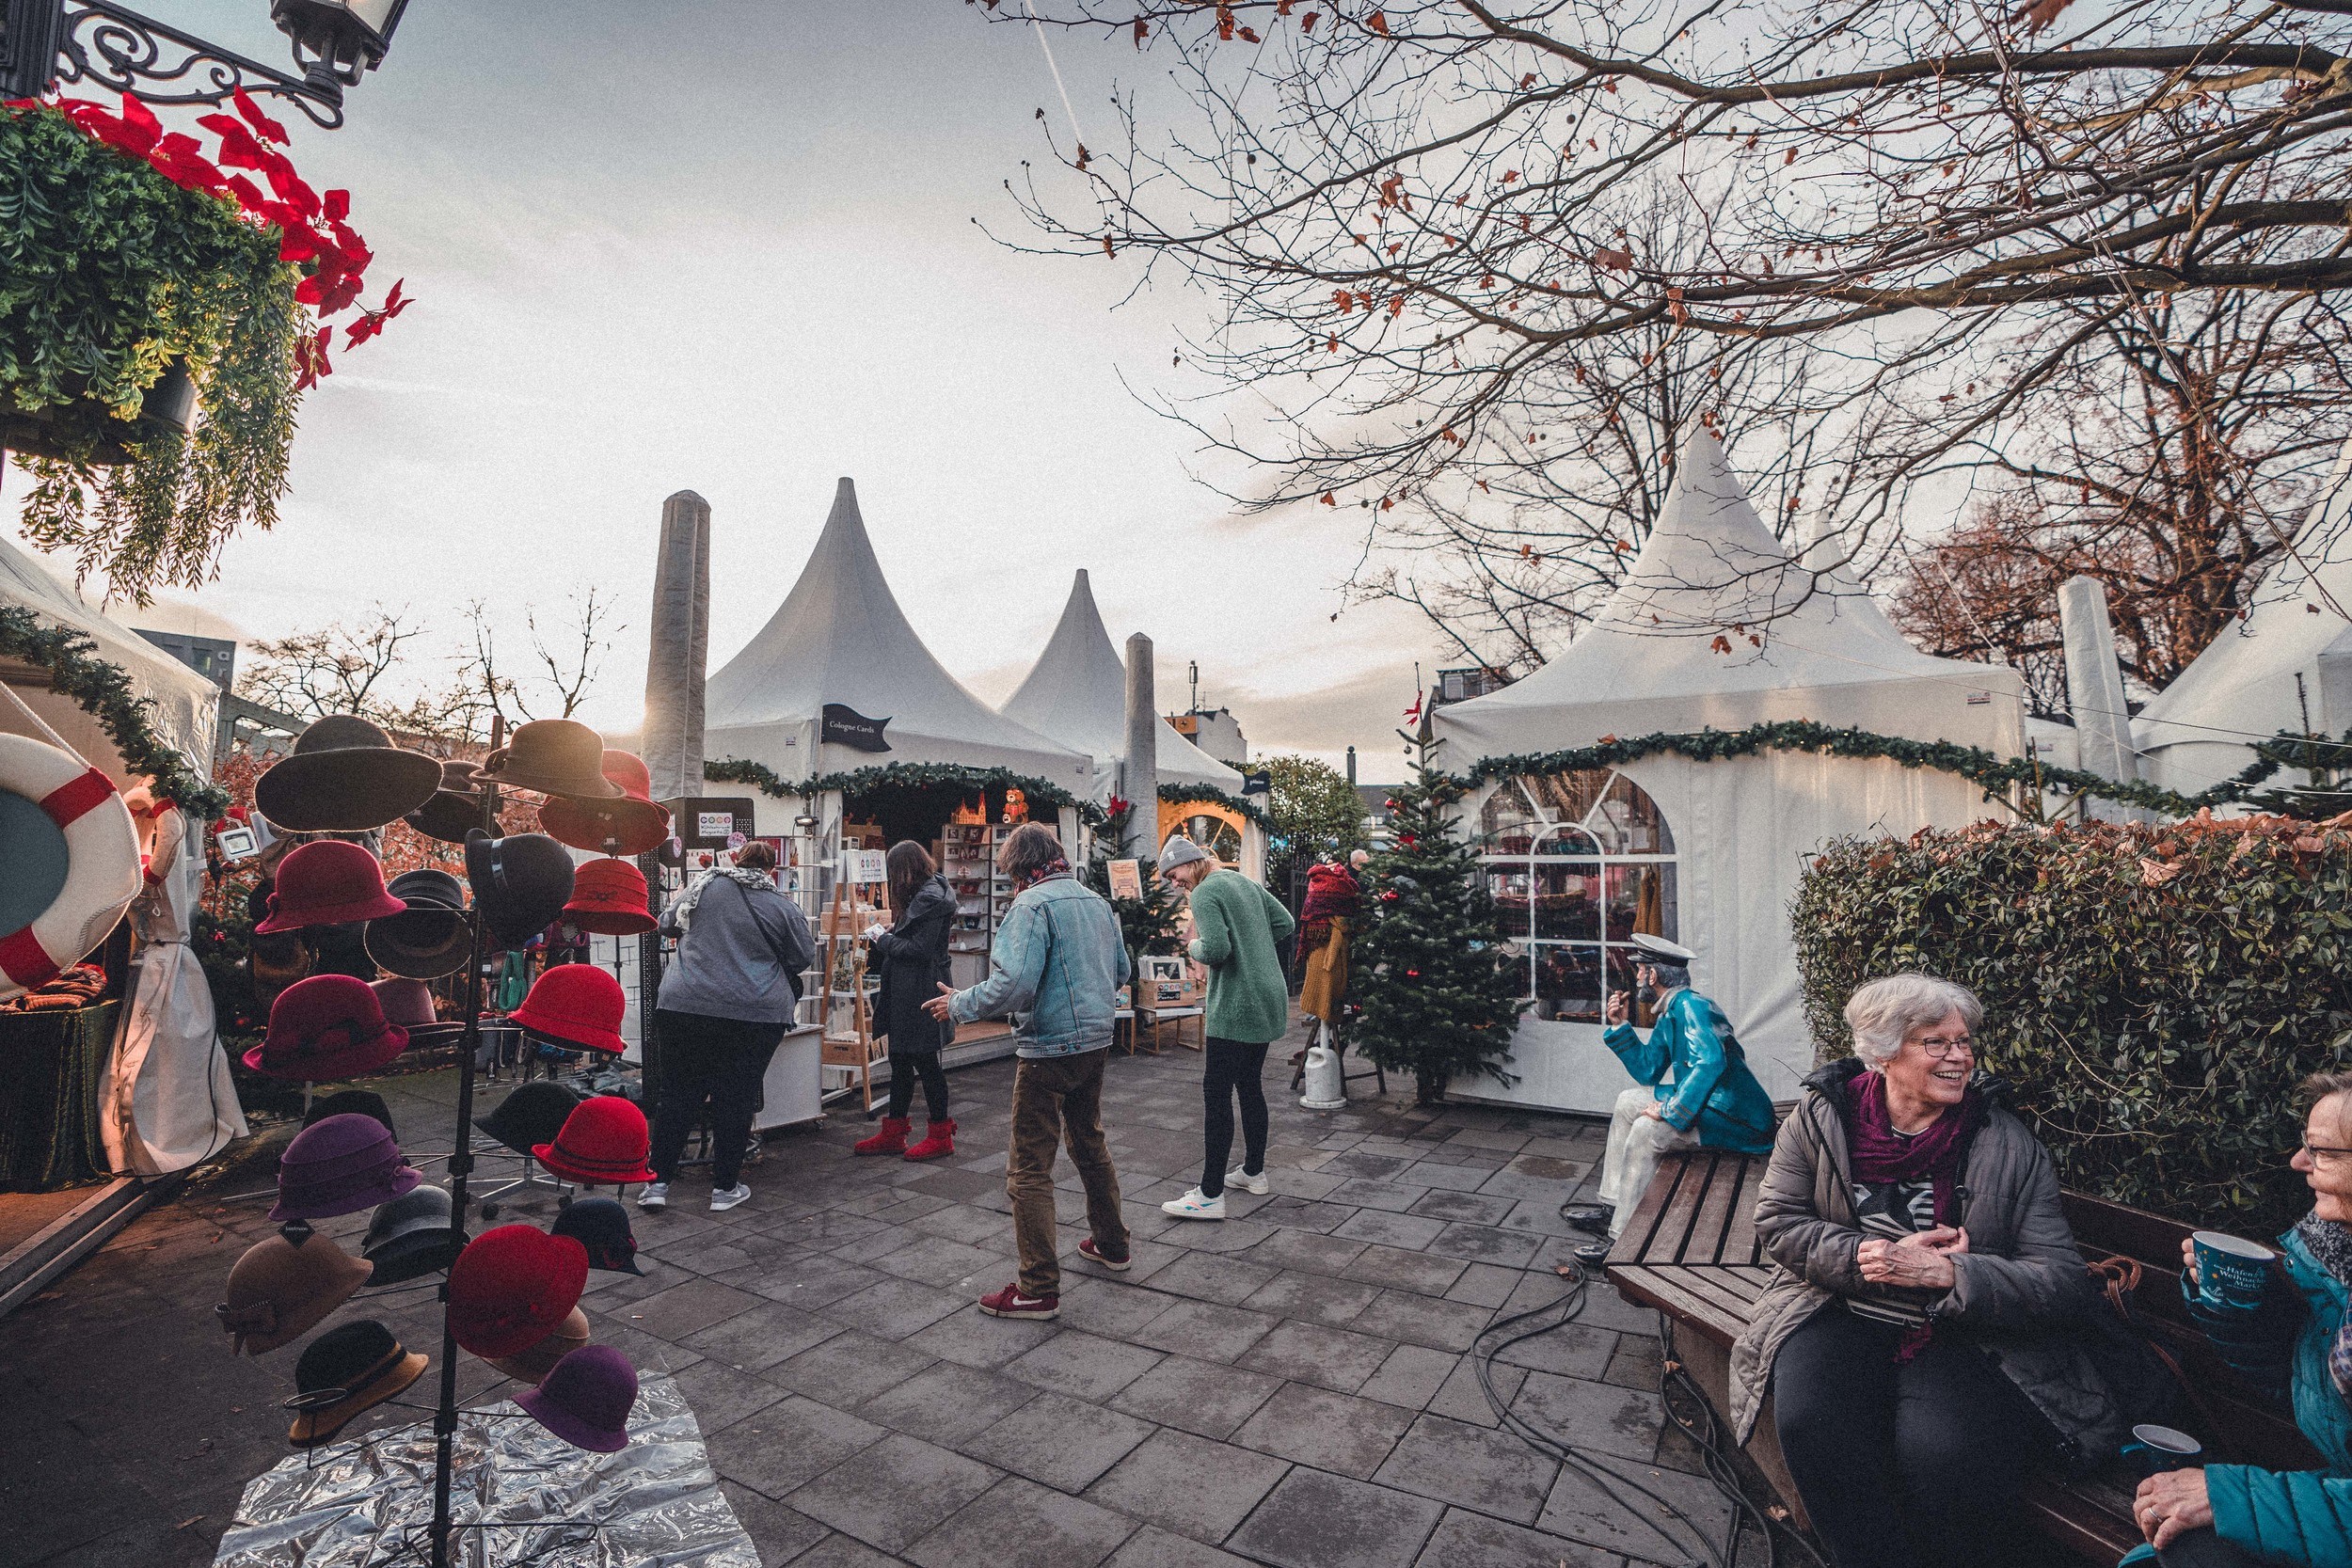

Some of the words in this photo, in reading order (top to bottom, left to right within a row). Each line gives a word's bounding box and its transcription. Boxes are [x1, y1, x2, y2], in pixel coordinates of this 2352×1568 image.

[829, 721, 856, 732] Cologne
[857, 724, 875, 734] Cards
[2227, 1266, 2253, 1277] Hafen
